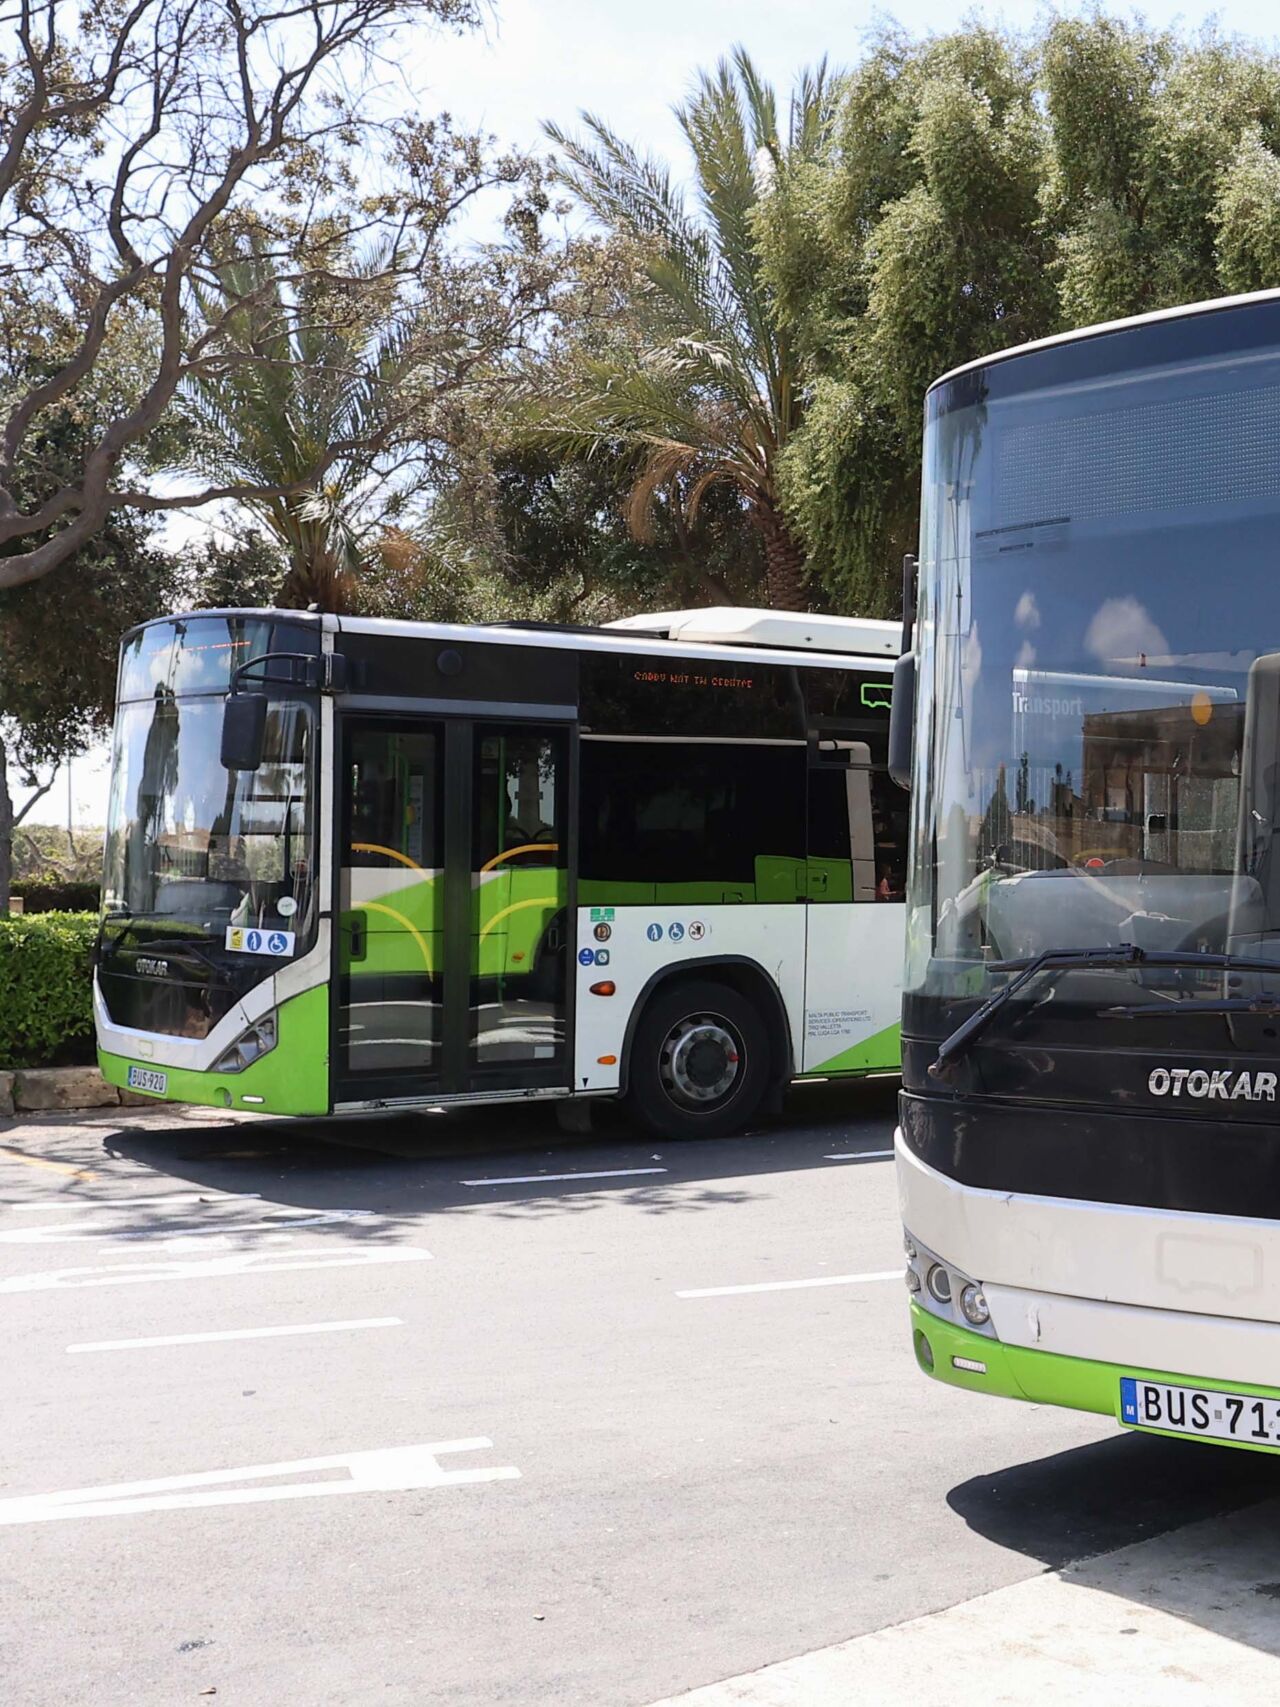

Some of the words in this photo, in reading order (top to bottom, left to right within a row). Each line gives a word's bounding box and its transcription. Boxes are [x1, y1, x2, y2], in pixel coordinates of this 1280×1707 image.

[1012, 692, 1082, 720] Transport
[136, 957, 168, 976] OTOKAR
[1148, 1068, 1278, 1101] OTOKAR
[1126, 1404, 1135, 1415] M
[1144, 1386, 1210, 1429] BUS
